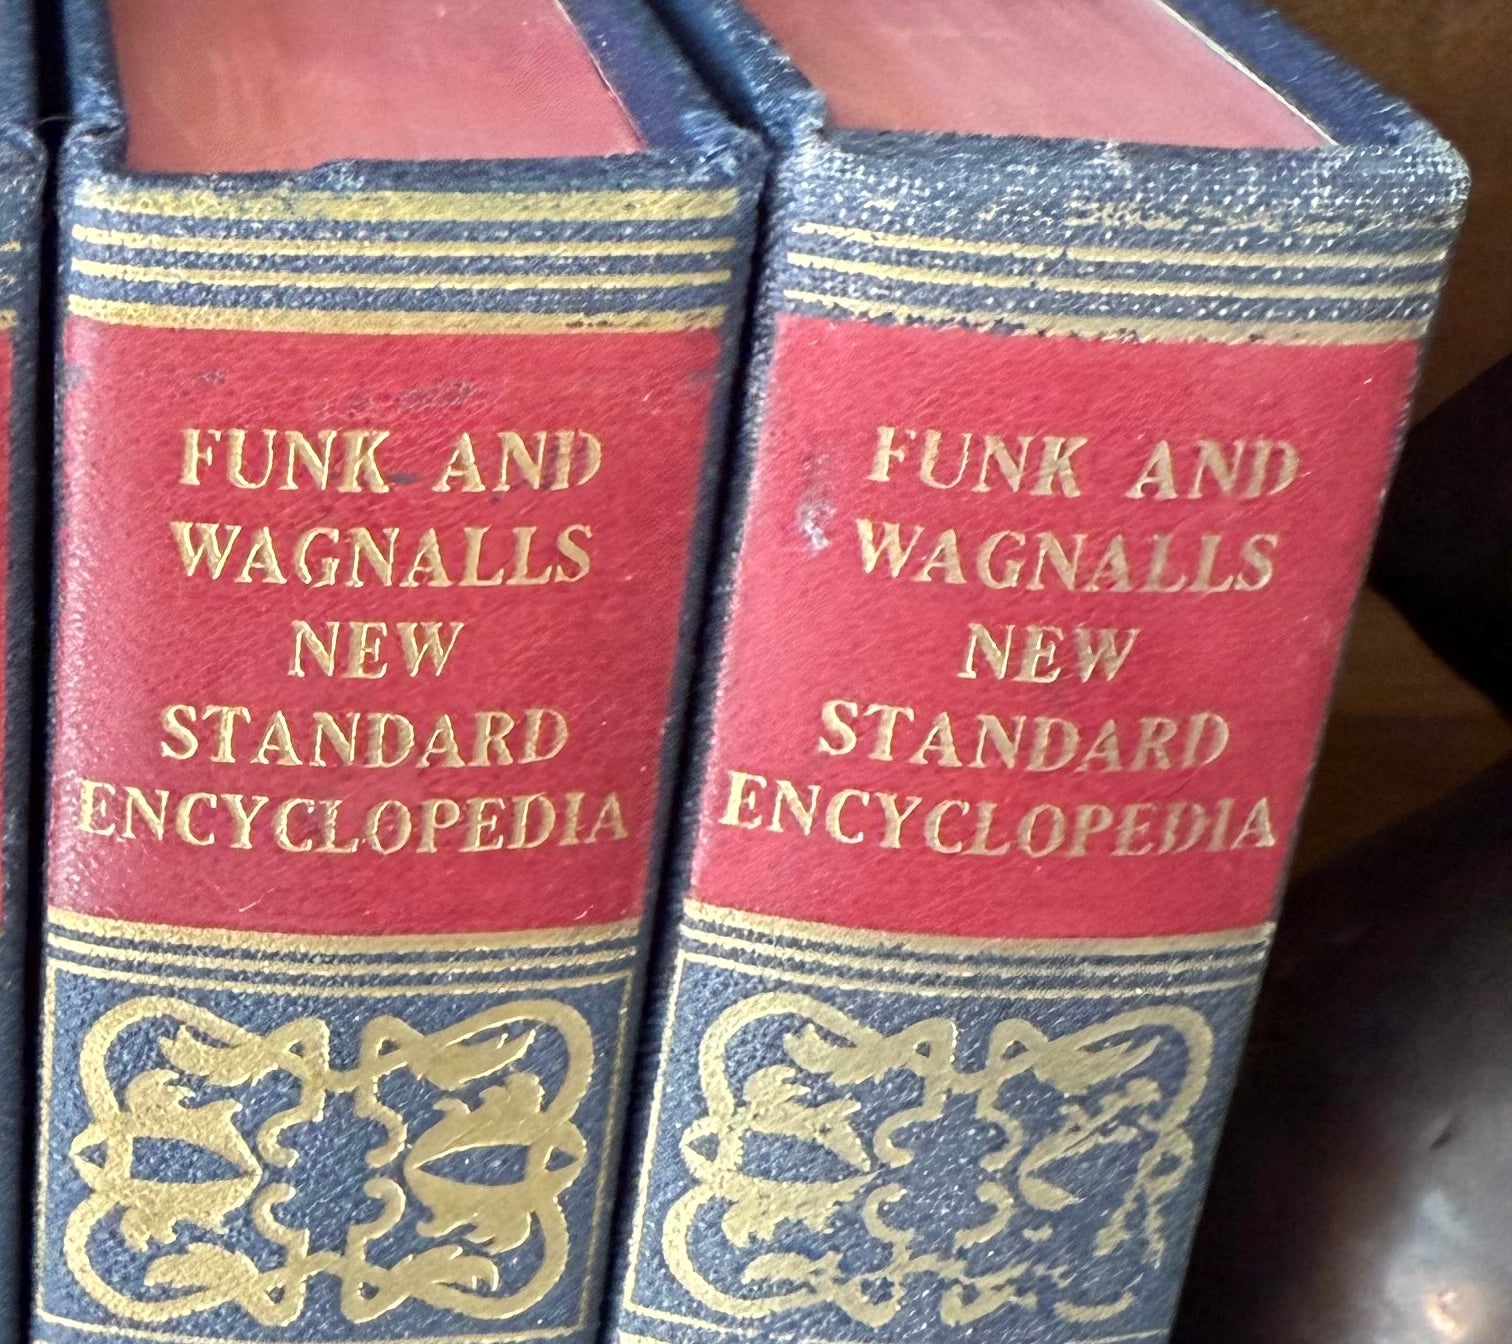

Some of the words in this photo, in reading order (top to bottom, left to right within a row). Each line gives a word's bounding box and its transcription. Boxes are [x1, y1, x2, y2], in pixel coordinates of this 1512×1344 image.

[179, 428, 391, 493] FUNK
[431, 431, 603, 493] AND
[867, 425, 1088, 498] FUNK
[1125, 438, 1300, 501] AND
[171, 521, 593, 588] WAGNALLS
[855, 517, 1278, 594] WAGNALLS
[288, 620, 465, 679] NEW
[957, 622, 1140, 684] NEW
[161, 704, 570, 768] STANDARD
[817, 699, 1230, 773] STANDARD
[78, 779, 629, 855] ENCYCLOPEDIA
[718, 769, 1276, 857] ENCYCLOPEDIA
